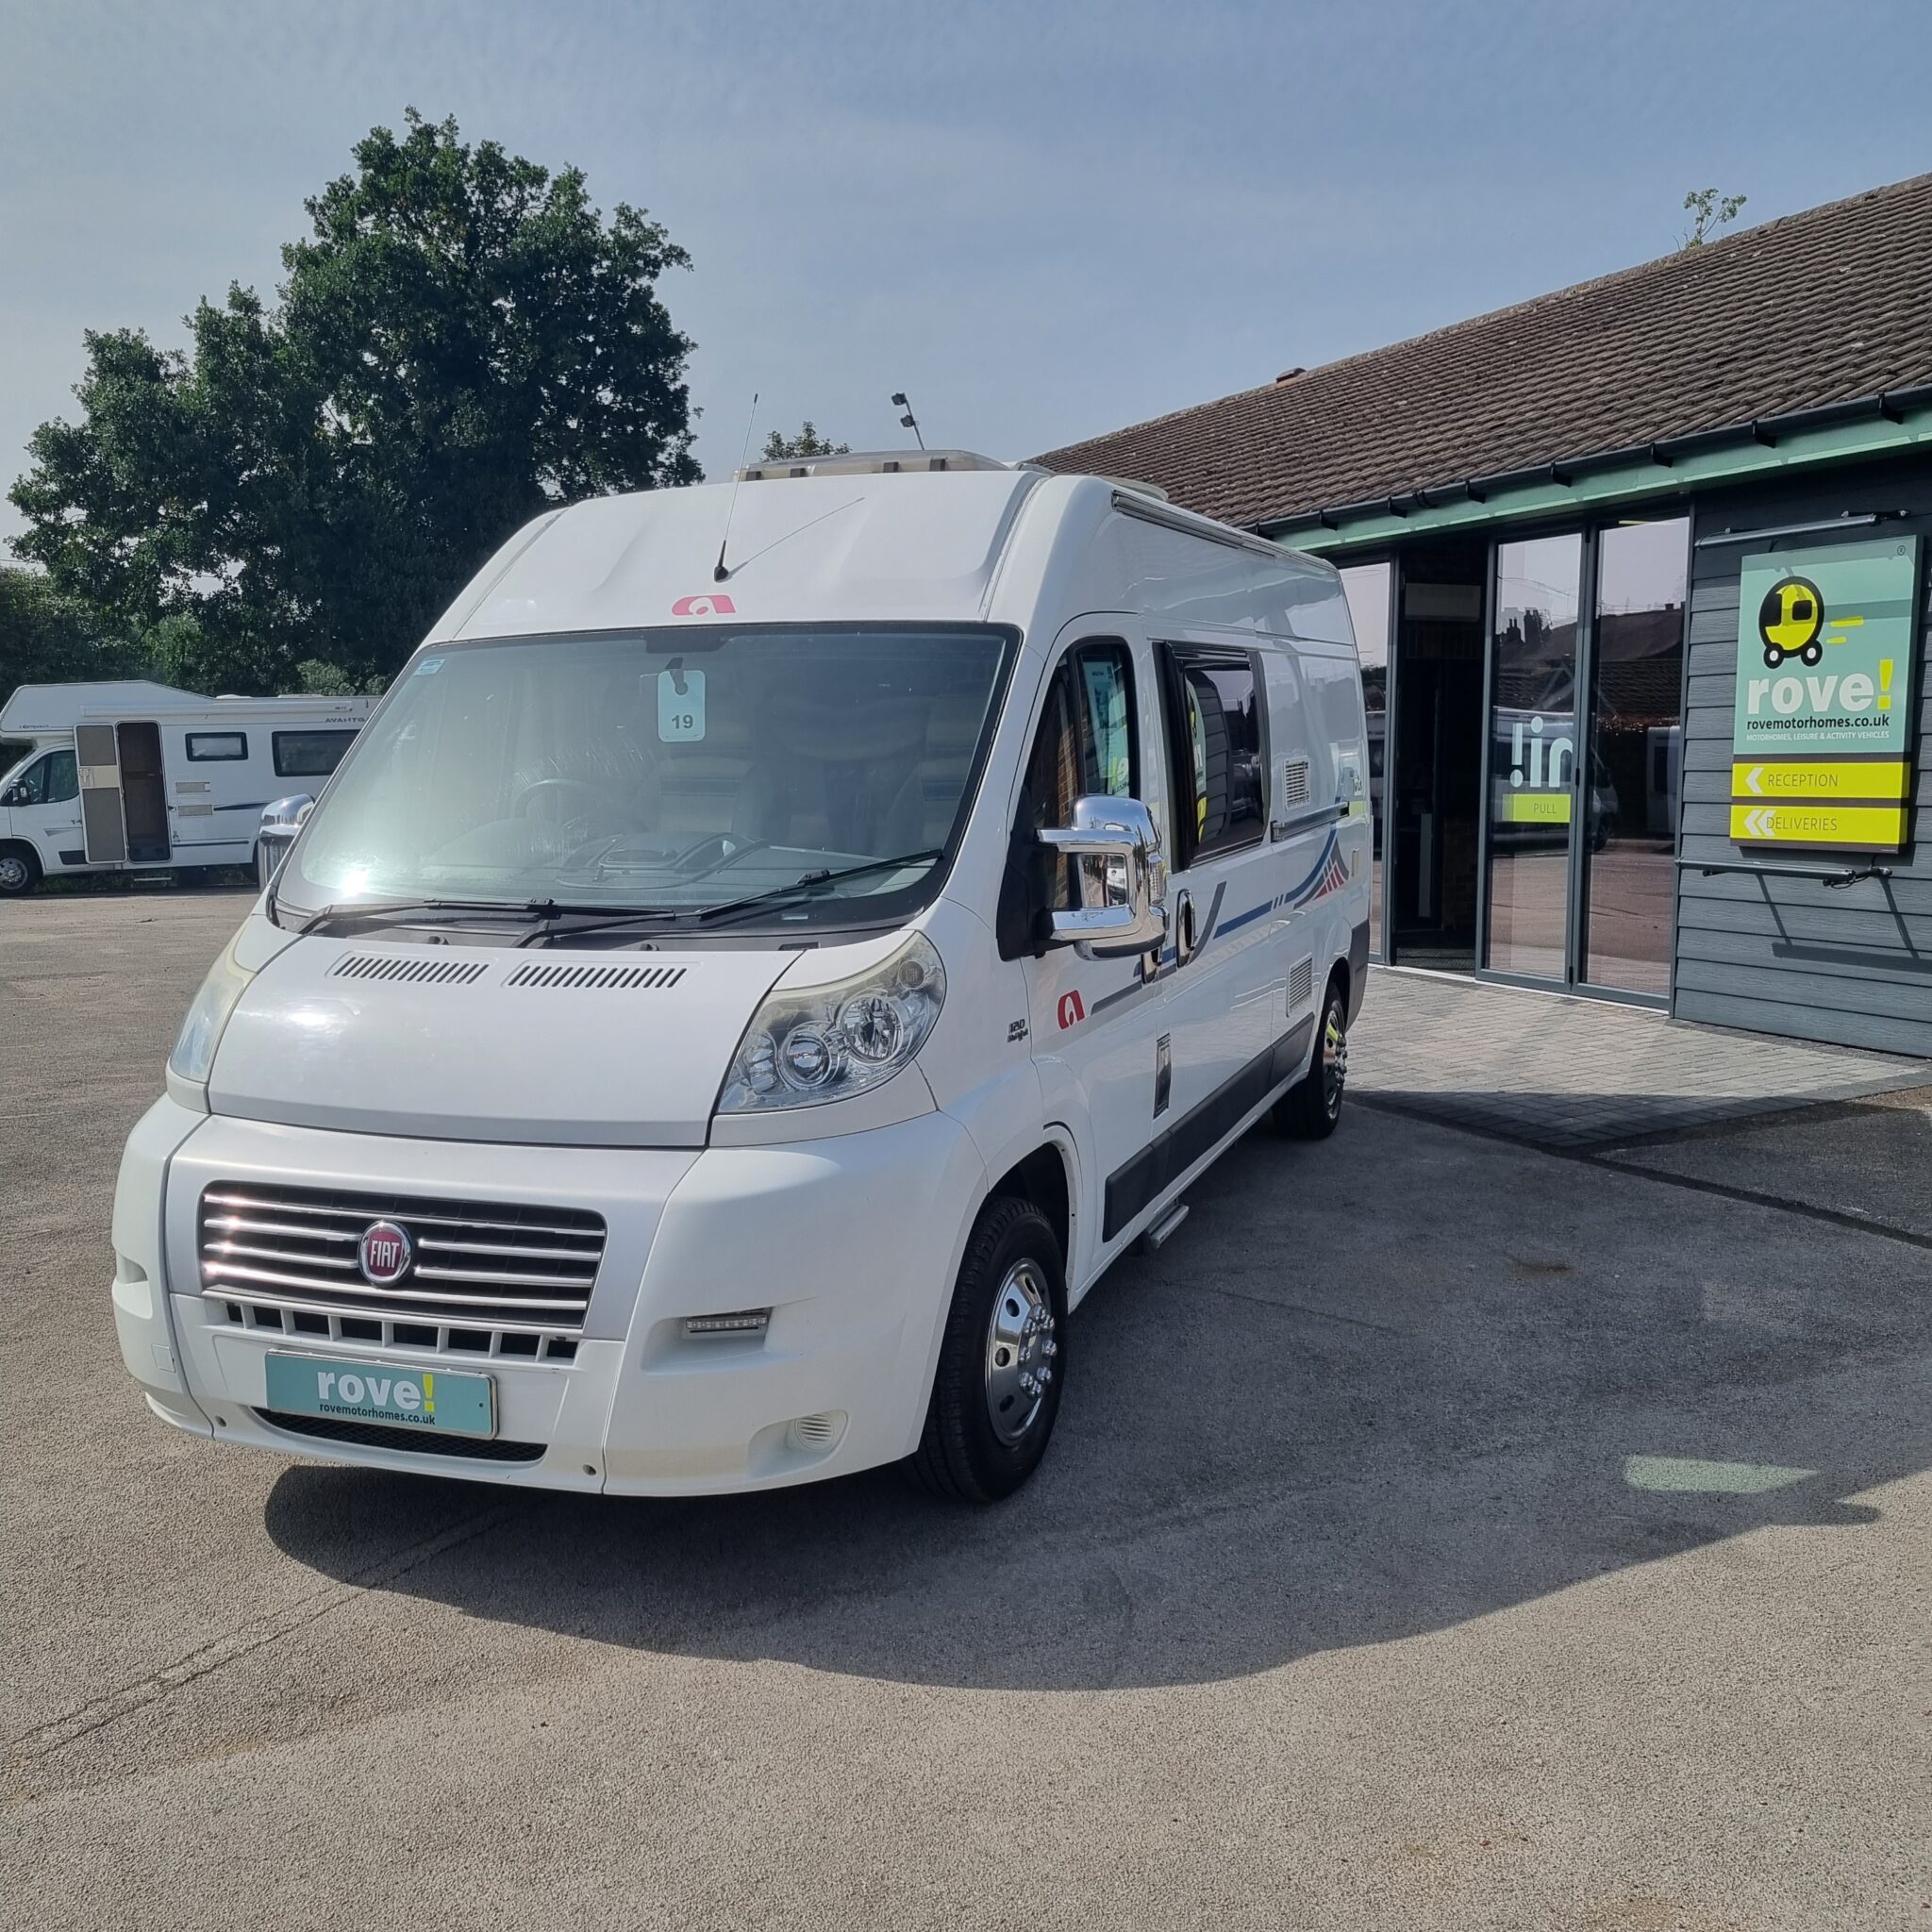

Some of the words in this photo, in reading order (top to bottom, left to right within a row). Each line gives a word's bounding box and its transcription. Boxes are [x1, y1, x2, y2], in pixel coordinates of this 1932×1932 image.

[1747, 658, 1893, 715] rove!
[672, 714, 693, 729] 19
[1746, 713, 1890, 730] rovemotorhomes.co.uk
[1793, 731, 1818, 741] LEISURE
[1825, 731, 1856, 740] ACTIVITY
[1857, 730, 1890, 740] VEHICLES
[1767, 774, 1839, 787] RECEPTION
[1533, 803, 1557, 814] PULL
[1766, 816, 1838, 831] DELIVERIES
[370, 1240, 400, 1269] FIAT
[317, 1372, 434, 1412] rove!
[319, 1403, 436, 1425] rovemotorhomes.co.uk
